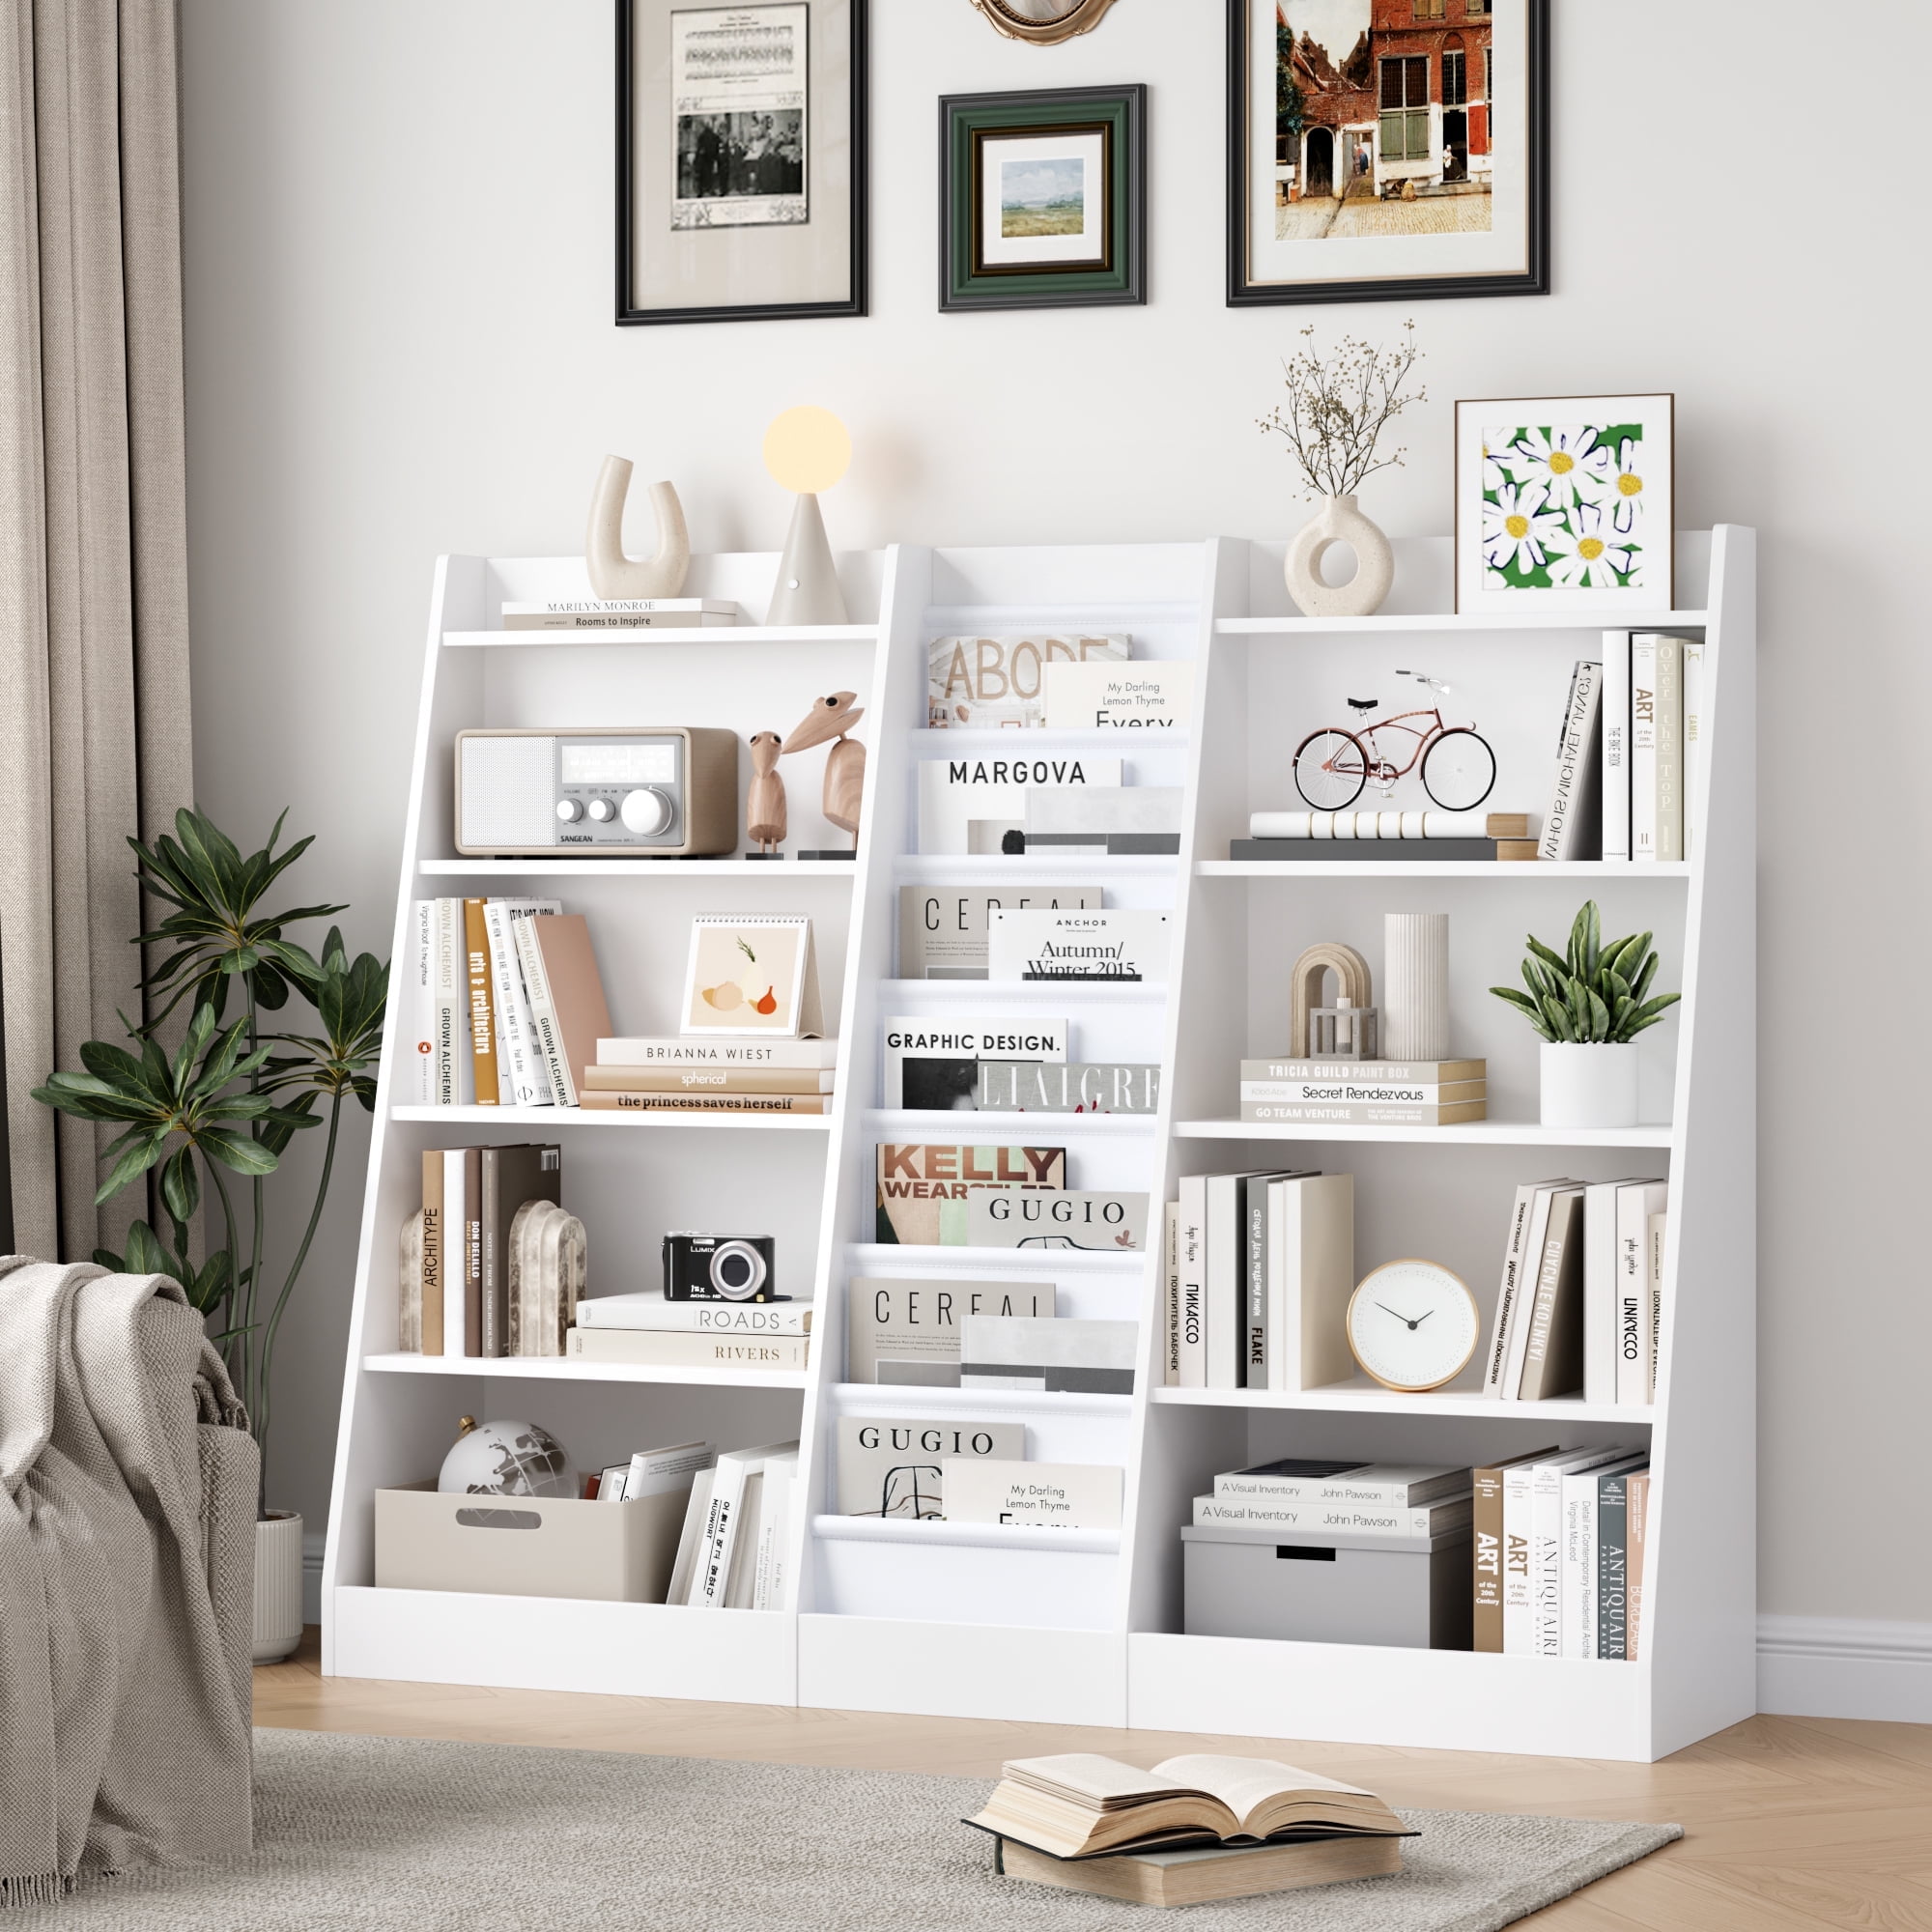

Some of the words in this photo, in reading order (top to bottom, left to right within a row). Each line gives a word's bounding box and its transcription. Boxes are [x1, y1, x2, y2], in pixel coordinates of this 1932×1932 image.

[548, 602, 601, 611] MARILYN
[605, 601, 655, 611] MONROE
[576, 617, 606, 626] Rooms
[608, 617, 617, 626] to
[620, 616, 651, 628] Inspire
[1107, 682, 1122, 694] My
[1125, 680, 1160, 694] Darling
[1102, 696, 1132, 705] Lemon
[1135, 695, 1165, 707] Thyme
[1636, 688, 1654, 723] ART
[1688, 715, 1697, 742] EAMES
[950, 761, 1086, 783] MARGOVA
[441, 933, 451, 989] ALCHEMIST
[1040, 941, 1124, 960] Autumn/
[525, 951, 544, 1000] ALCHEMIST
[1028, 960, 1091, 976] Winter
[1092, 962, 1136, 976] 2015
[441, 1008, 451, 1047] GROWN
[472, 990, 491, 1055] architecture
[646, 1047, 718, 1059] BRIANNA
[726, 1048, 772, 1060] WIEST
[887, 1033, 975, 1050] GRAPHIC
[983, 1036, 1061, 1051] DESIGN.
[541, 1017, 555, 1054] GROWN
[550, 1058, 568, 1106] ALCHEMIS
[1268, 1065, 1308, 1078] TRICIA
[1314, 1065, 1350, 1078] GUILD
[1352, 1066, 1384, 1079] PAINT
[1388, 1067, 1409, 1079] BOX
[441, 1051, 451, 1104] ALCHEMIS
[681, 1070, 726, 1087] spherical
[618, 1094, 640, 1107] the
[643, 1096, 703, 1110] princess
[703, 1099, 742, 1109] saves
[743, 1097, 793, 1110] herself
[1302, 1086, 1343, 1100] Secret
[1347, 1087, 1424, 1101] Rendezvous
[1256, 1108, 1271, 1118] GO
[1273, 1108, 1302, 1119] TEAM
[1305, 1109, 1350, 1120] VENTURE
[883, 1145, 1064, 1181] KELLY
[989, 1198, 1125, 1223] GUGIO
[471, 1221, 480, 1239] DON
[425, 1208, 438, 1287] ARCHITYPE
[471, 1242, 480, 1278] DELILLO
[699, 1310, 780, 1329] ROADS
[1185, 1284, 1199, 1344] ПИКАССО
[715, 1347, 781, 1360] RIVERS
[1252, 1327, 1264, 1364] FLAKE
[859, 1427, 993, 1454] GUGIO
[1010, 1485, 1026, 1496] My
[1029, 1485, 1065, 1498] Darling
[1221, 1483, 1230, 1492] A
[1231, 1483, 1257, 1493] Visual
[1259, 1484, 1300, 1496] Inventory
[1321, 1489, 1344, 1498] John
[1346, 1490, 1381, 1500] Pawson
[1006, 1498, 1036, 1509] Lemon
[1038, 1499, 1070, 1513] Thyme
[1203, 1506, 1211, 1517] A
[1213, 1507, 1244, 1519] Visual
[1248, 1509, 1298, 1522] Inventory
[1323, 1513, 1350, 1525] John
[1353, 1515, 1397, 1527] Pawson
[1568, 1501, 1578, 1529] Virginia
[1582, 1500, 1591, 1522] Detail
[706, 1498, 719, 1540] MUGWORT
[1477, 1531, 1498, 1576] ART
[1508, 1534, 1528, 1577] ART
[1569, 1531, 1578, 1562] McLeod
[1580, 1533, 1591, 1587] Contemporary
[1506, 1599, 1529, 1607] Century
[1582, 1589, 1591, 1631] Residential
[1607, 1545, 1625, 1660] ANTIQUAIR
[1631, 1585, 1642, 1656] BORDEAUX
